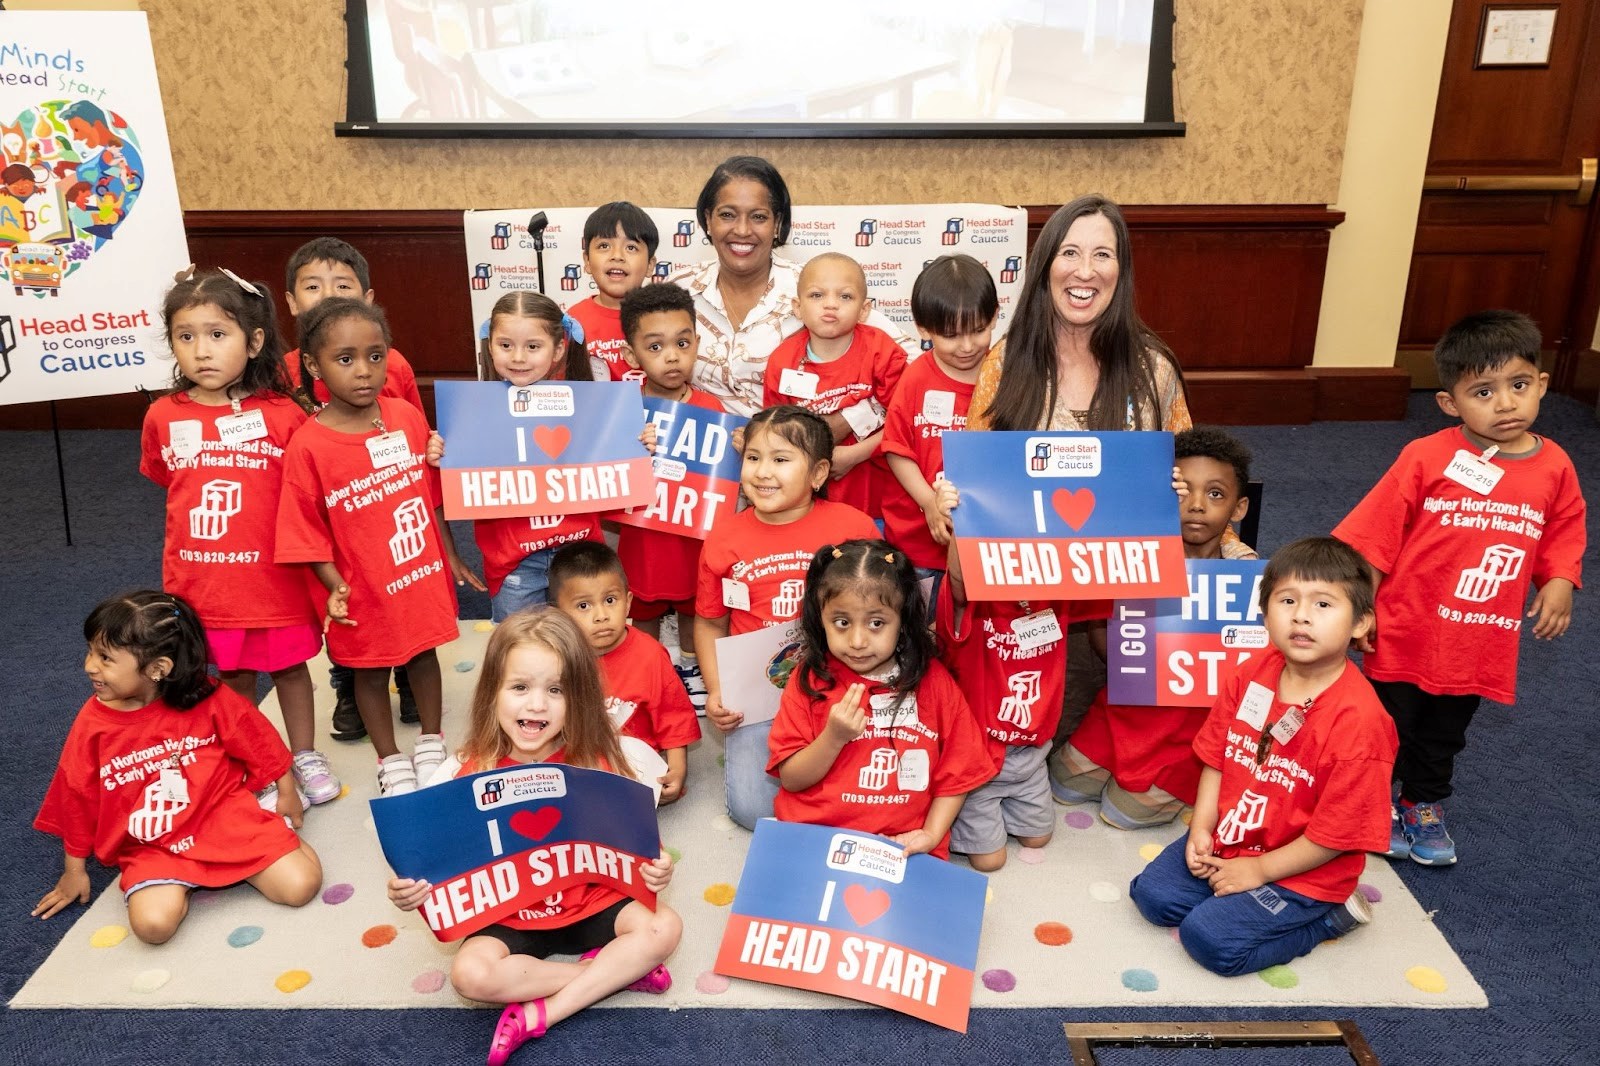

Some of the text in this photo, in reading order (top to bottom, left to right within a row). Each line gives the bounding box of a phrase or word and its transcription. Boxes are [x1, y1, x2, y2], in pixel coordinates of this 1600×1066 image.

[0, 42, 84, 72] Minds
[58, 73, 107, 101] Start
[545, 224, 562, 232] tart
[814, 221, 835, 230] Start
[879, 220, 926, 228] Head Start
[966, 218, 1014, 227] Head Start
[519, 240, 558, 249] Caus
[793, 237, 831, 246] Caucus
[884, 237, 921, 245] Caucus
[971, 235, 1009, 243] Caucus
[494, 265, 538, 273] Head Star
[861, 262, 902, 270] ead Start
[500, 281, 538, 289] Caucus
[867, 279, 898, 287] aucus
[878, 299, 902, 307] Head
[20, 309, 151, 336] Head Start
[42, 335, 136, 351] to Congress
[40, 350, 146, 373] Caucus
[221, 420, 262, 436] HVC-215
[516, 427, 527, 462] I
[644, 409, 728, 465] EAD
[373, 443, 407, 459] HVC-215
[201, 453, 234, 467] Head
[236, 454, 268, 470] Start
[1058, 461, 1093, 469] Caucus
[350, 465, 398, 493] Horizons
[1453, 461, 1493, 487] HVC-215
[344, 500, 353, 512] &
[353, 489, 383, 509] Early
[383, 474, 410, 495] Head
[461, 463, 631, 507] HEAD START
[643, 482, 726, 531] ART
[1033, 490, 1047, 533] I
[1423, 497, 1459, 513] Higher
[1461, 497, 1519, 516] Horizons
[1440, 513, 1451, 526] &
[1453, 513, 1490, 531] Early
[1491, 515, 1525, 534] Head
[754, 552, 794, 566] Horizons
[796, 550, 814, 559] Hea
[978, 541, 1160, 586] HEAD START
[754, 565, 777, 578] Early
[778, 561, 800, 571] Head
[1182, 574, 1265, 621] HEA
[1463, 612, 1521, 631] 820-2457
[1019, 623, 1057, 640] HVC-215
[1120, 606, 1146, 656] GOT
[897, 729, 919, 744] Start
[111, 744, 165, 770] Horizons
[1225, 745, 1233, 758] &
[104, 778, 116, 791] &
[114, 766, 145, 785] Early
[180, 751, 196, 767] art
[506, 775, 533, 784] Head
[513, 786, 557, 796] Caucus
[866, 794, 910, 804] 820-2457
[487, 819, 503, 857] I
[858, 844, 902, 863] Head Start
[870, 855, 896, 867] Congress
[859, 859, 896, 876] Caucus
[423, 843, 635, 931] HEAD START
[818, 881, 836, 921] I
[740, 921, 947, 1006] HEAD START
